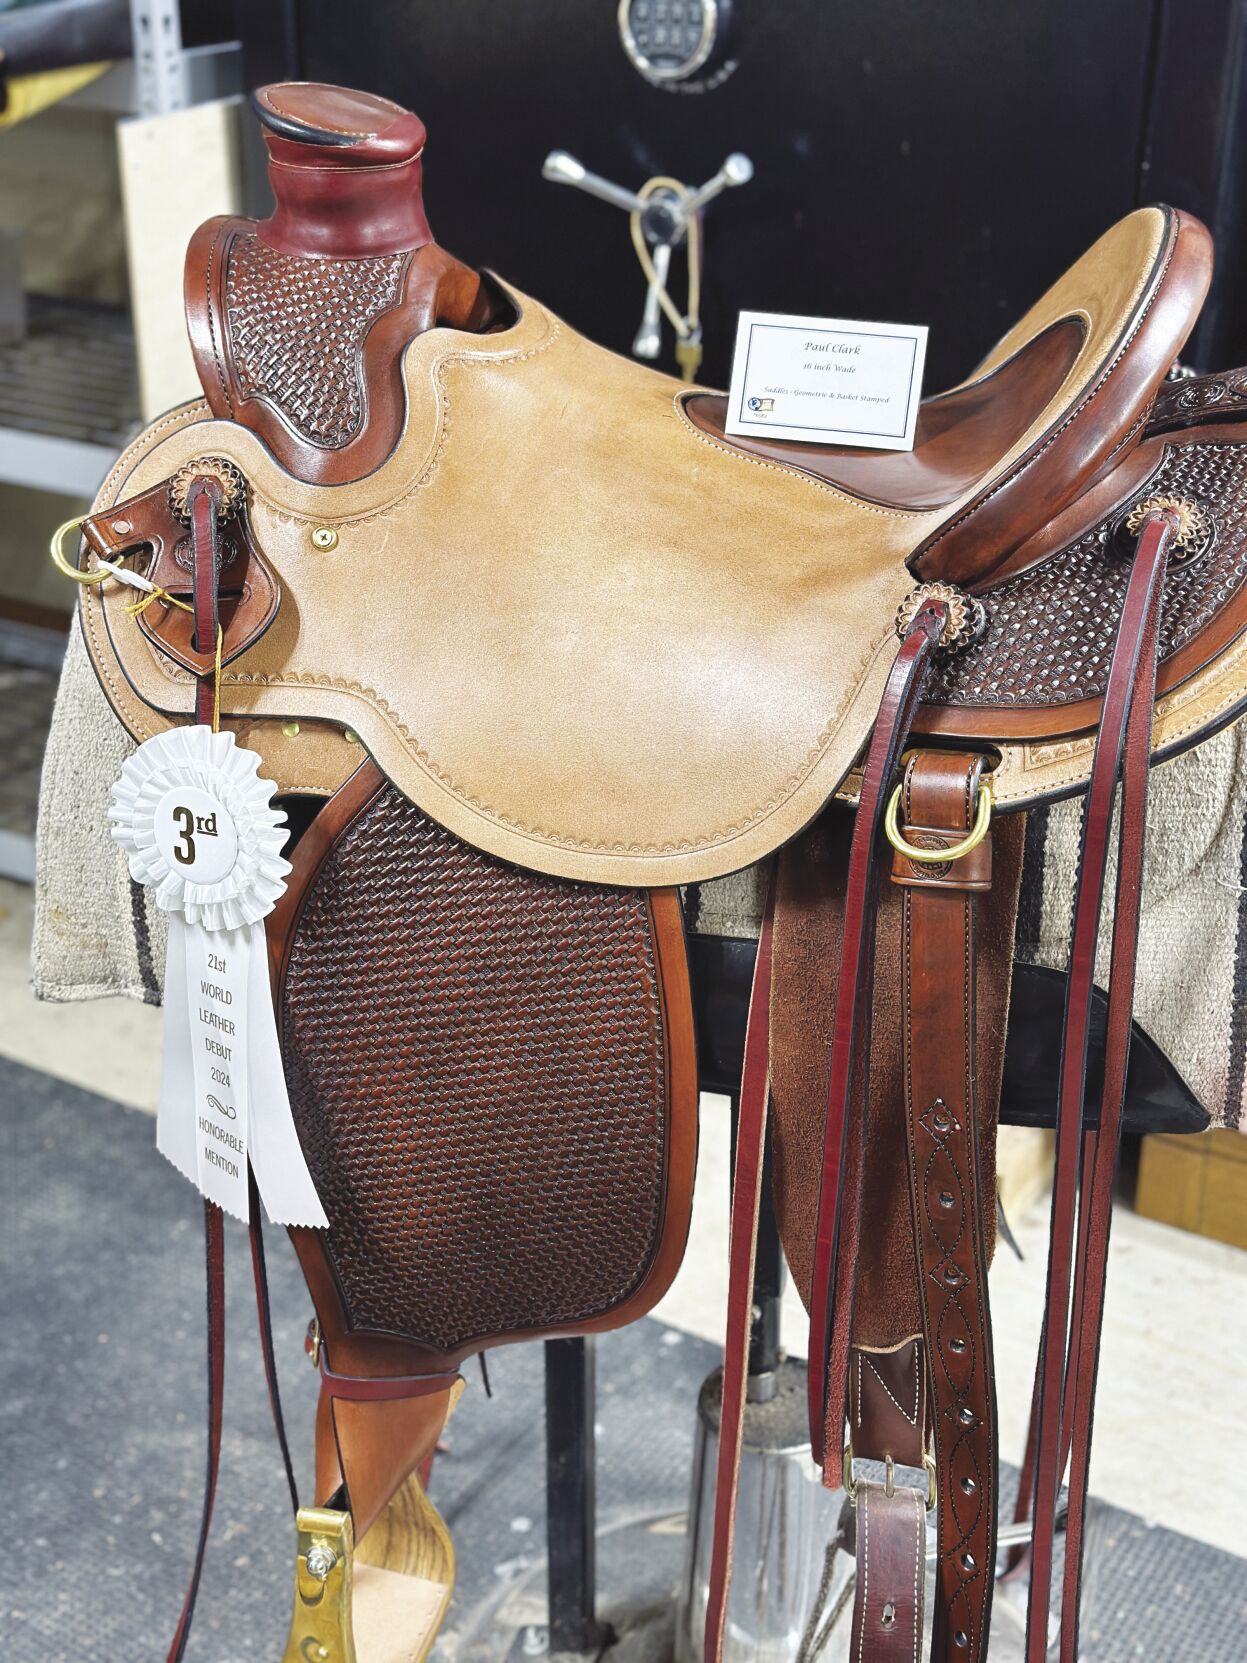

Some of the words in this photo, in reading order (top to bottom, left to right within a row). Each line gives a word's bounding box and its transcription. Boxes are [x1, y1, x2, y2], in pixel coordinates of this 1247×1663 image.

[804, 342, 830, 353] Paul
[832, 343, 861, 355] Clark
[814, 363, 831, 372] inch
[834, 364, 856, 373] Wade
[764, 386, 789, 395] Saddles
[794, 389, 828, 398] Geometric
[836, 392, 859, 401] Basket
[860, 394, 890, 404] Stamped
[173, 806, 218, 865] 3rd
[207, 953, 227, 974] 21st
[200, 979, 233, 1005] WORLD
[199, 1007, 235, 1036] LEATHER
[205, 1037, 232, 1062] DEBUT
[211, 1066, 231, 1088] 2024
[199, 1116, 244, 1155] HONORABLE
[205, 1149, 239, 1179] MENTION
